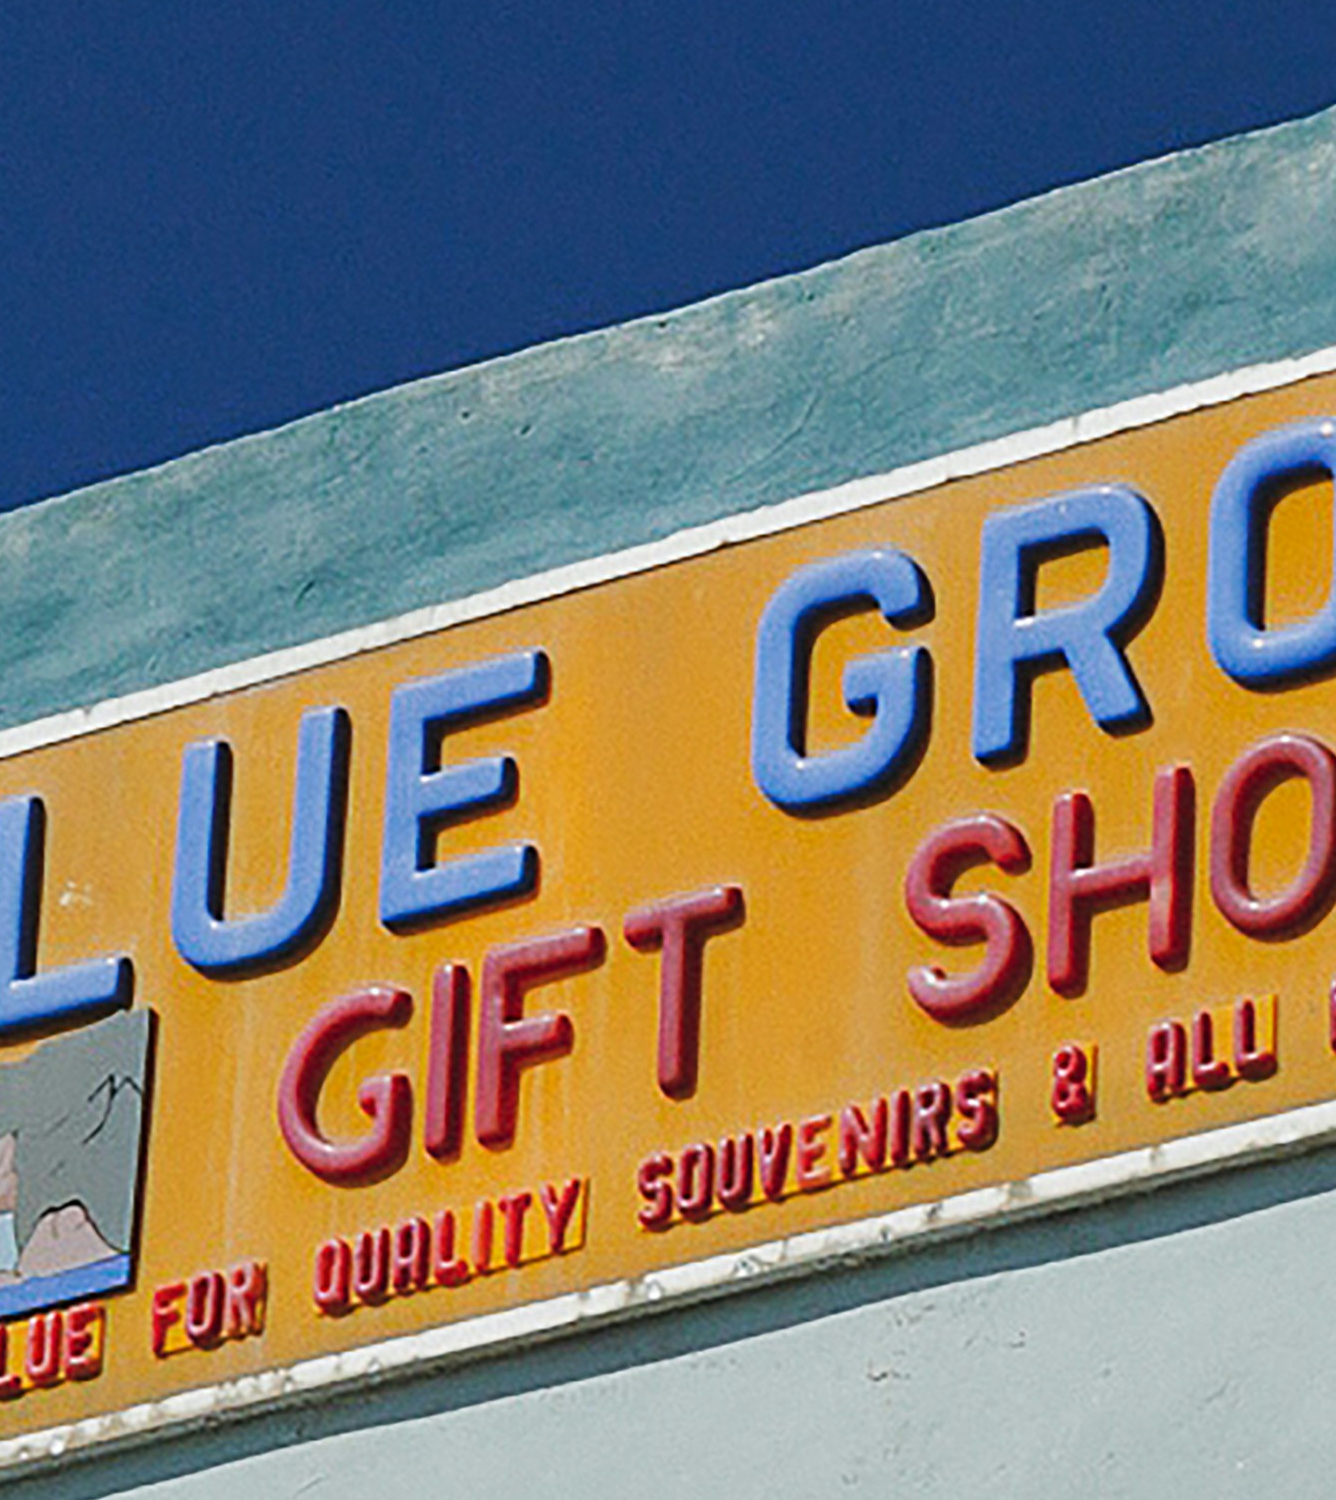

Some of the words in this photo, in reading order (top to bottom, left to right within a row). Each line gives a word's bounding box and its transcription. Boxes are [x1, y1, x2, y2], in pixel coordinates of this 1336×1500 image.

[151, 1261, 267, 1357] FOR
[313, 1177, 585, 1316] QUALITY
[636, 1068, 999, 1232] SOUVENIRS
[1146, 995, 1277, 1104] ALL
[276, 884, 745, 1188] GIFT
